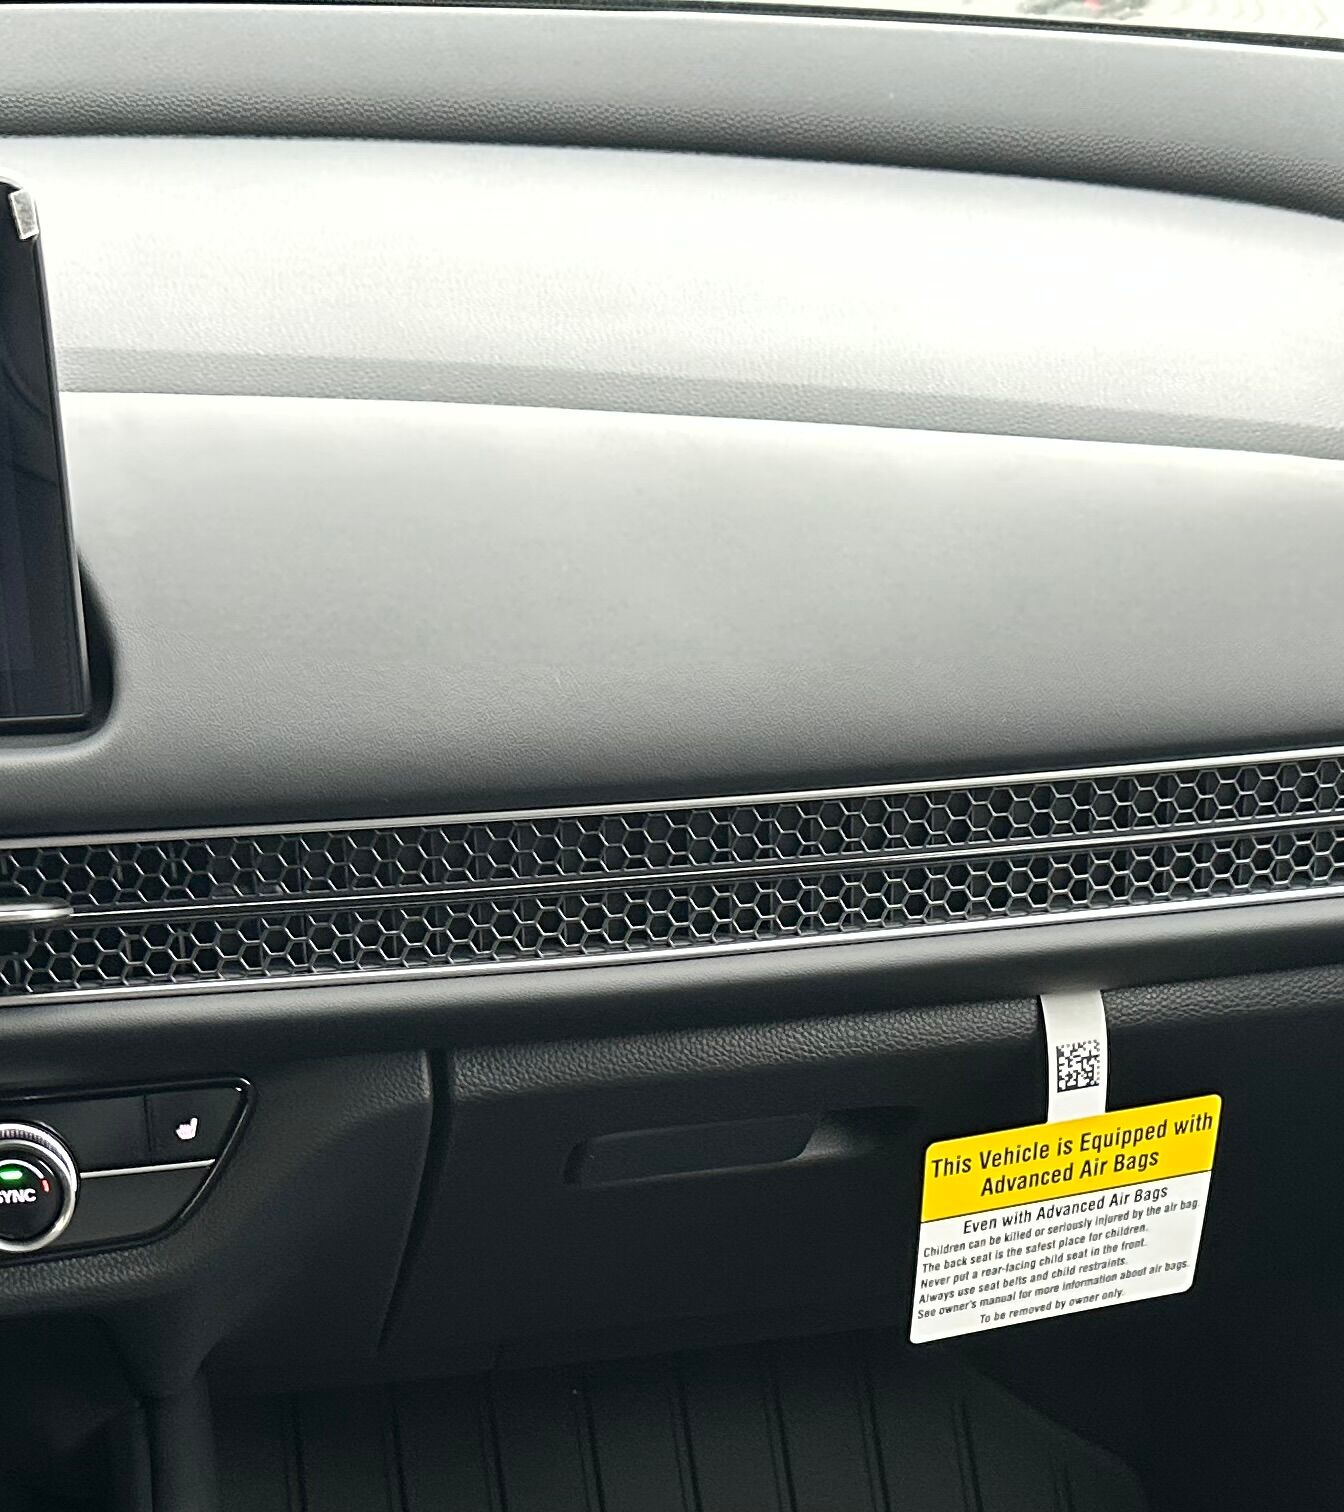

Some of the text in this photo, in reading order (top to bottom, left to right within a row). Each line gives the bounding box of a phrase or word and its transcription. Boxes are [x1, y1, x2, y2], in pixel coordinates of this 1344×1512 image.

[931, 1111, 1213, 1179] This Vehicle is Equipped with
[980, 1151, 1160, 1197] Advanced Air Bags
[923, 1242, 966, 1258] Children
[968, 1238, 987, 1250] can
[989, 1235, 1002, 1246] be
[1004, 1227, 1033, 1243] killed
[1034, 1227, 1046, 1238] or
[1047, 1217, 1093, 1235] seriously
[1094, 1209, 1130, 1227] injured
[1131, 1209, 1144, 1221] by
[1145, 1205, 1162, 1217] the
[1163, 1201, 1178, 1214] air
[963, 1186, 1169, 1235] Even with Advanced Air Bags
[920, 1275, 951, 1289] Never
[952, 1270, 970, 1285] put
[971, 1270, 979, 1280] a
[981, 1259, 1037, 1277] rear-facing
[1038, 1252, 1064, 1267] child
[1066, 1248, 1089, 1262] seat
[1090, 1247, 1101, 1257] in
[1102, 1244, 1119, 1255] the
[922, 1262, 941, 1274] The
[943, 1255, 968, 1270] back
[969, 1251, 993, 1265] seat
[994, 1249, 1004, 1260] is
[1006, 1246, 1023, 1258] the
[1025, 1239, 1056, 1255] safest
[1058, 1235, 1086, 1250] place
[1088, 1232, 1103, 1243] for
[917, 1308, 937, 1320] See
[979, 1290, 1017, 1308] manual
[1018, 1289, 1033, 1300] for
[1034, 1284, 1060, 1297] more
[1061, 1273, 1118, 1292] information
[1119, 1266, 1148, 1281] about
[1148, 1264, 1163, 1275] air
[918, 1290, 955, 1305] Always
[957, 1286, 976, 1297] use
[978, 1279, 1001, 1293] seat
[1002, 1275, 1028, 1289] belts
[1029, 1269, 1049, 1283] and
[1051, 1264, 1076, 1279] child
[979, 1313, 991, 1324] To
[993, 1311, 1007, 1322] be
[1008, 1300, 1053, 1319] removed
[1054, 1299, 1067, 1310] by
[1068, 1293, 1100, 1307] owner
